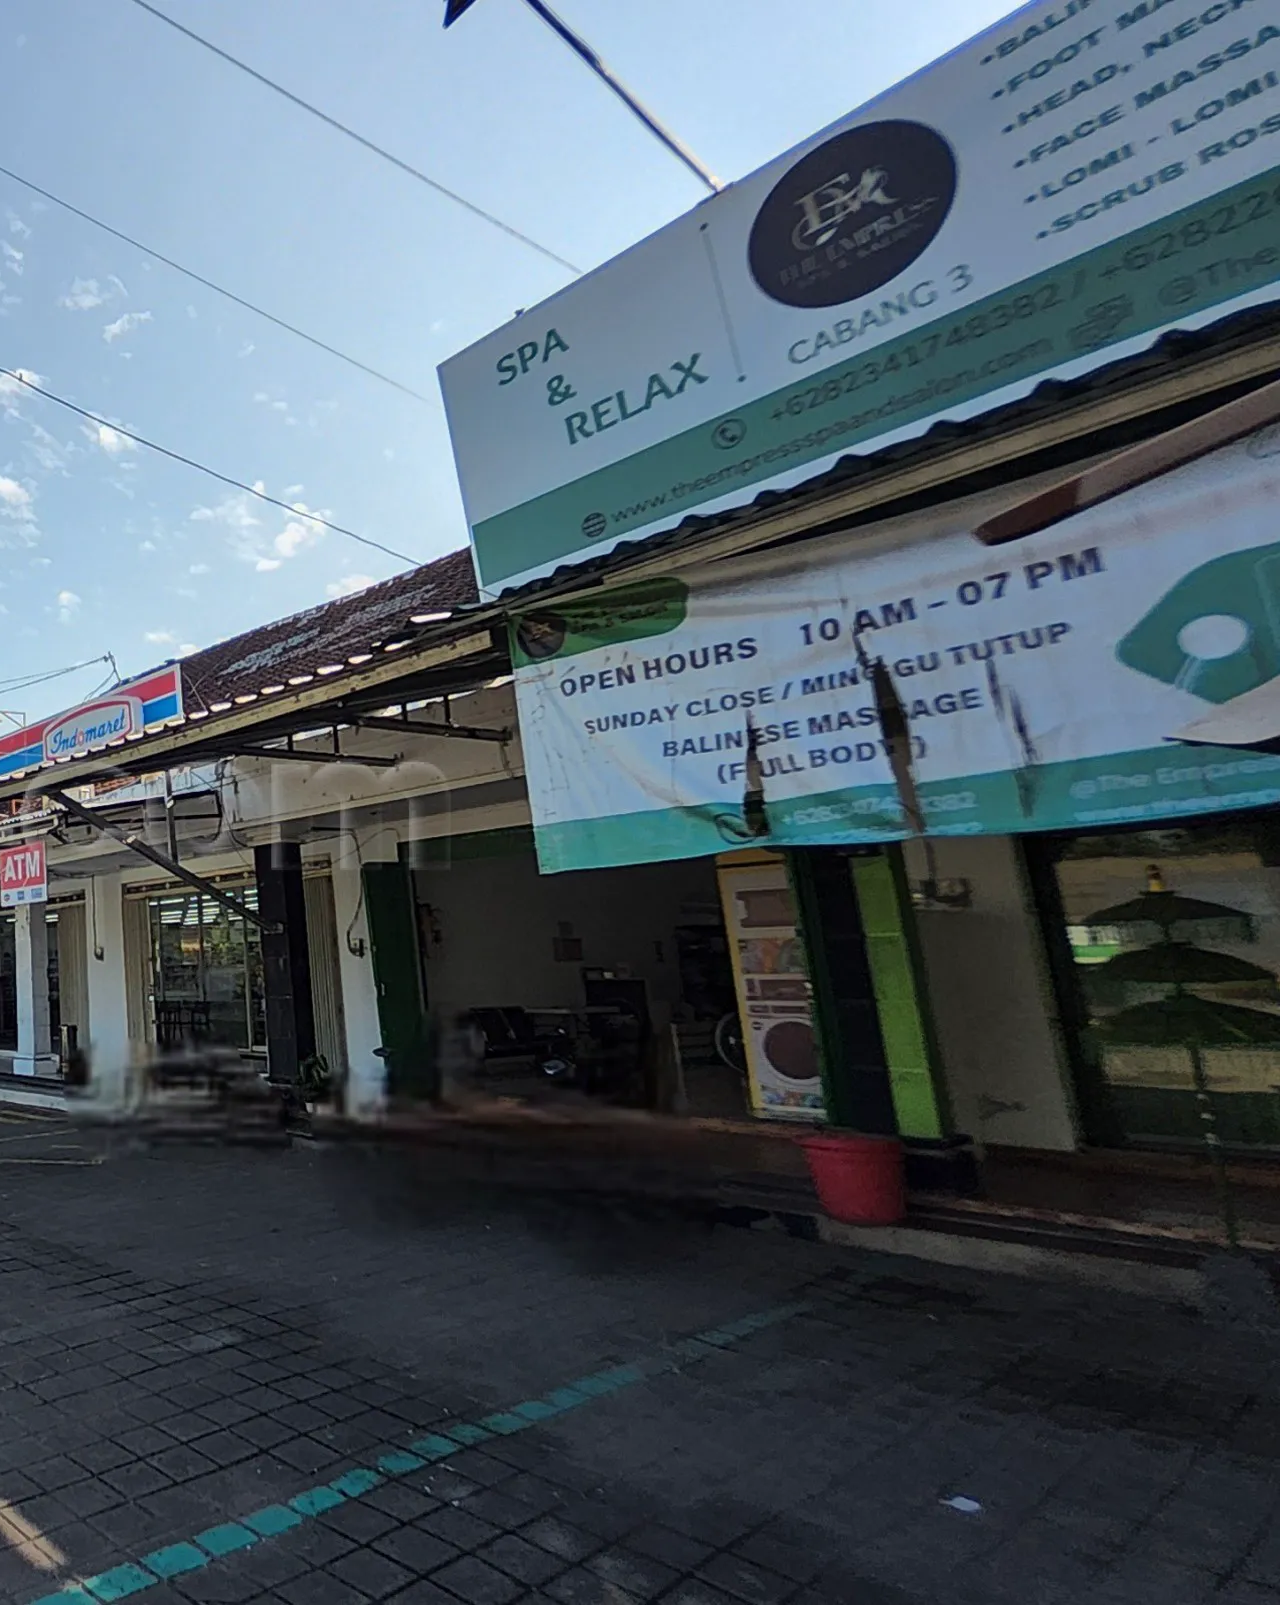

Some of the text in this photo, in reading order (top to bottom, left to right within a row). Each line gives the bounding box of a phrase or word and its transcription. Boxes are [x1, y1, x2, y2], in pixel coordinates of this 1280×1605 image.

[995, 0, 1091, 60] BALI
[1005, 25, 1107, 94] FOOT
[1028, 103, 1126, 163] FACE
[1040, 142, 1136, 198] LOMI
[1171, 70, 1279, 136] LOMI
[1051, 161, 1188, 234] SCRUB
[1098, 183, 1280, 280] +62822
[787, 263, 974, 365] CABANG 3
[496, 328, 570, 386] SPA
[546, 374, 578, 407] &
[564, 352, 710, 446] RELAX
[560, 664, 636, 698] OPEN
[641, 637, 759, 681] HOURS
[799, 617, 841, 646] 10
[853, 597, 919, 637] AM
[956, 571, 1011, 606] 07
[1022, 546, 1108, 590] PM
[584, 703, 680, 735] SUNDAY
[685, 686, 775, 717] CLOSE
[945, 621, 1072, 667] TUTUP
[807, 687, 984, 734] MASAGE
[50, 708, 126, 754] Indomaret
[4, 850, 40, 883] ATM
